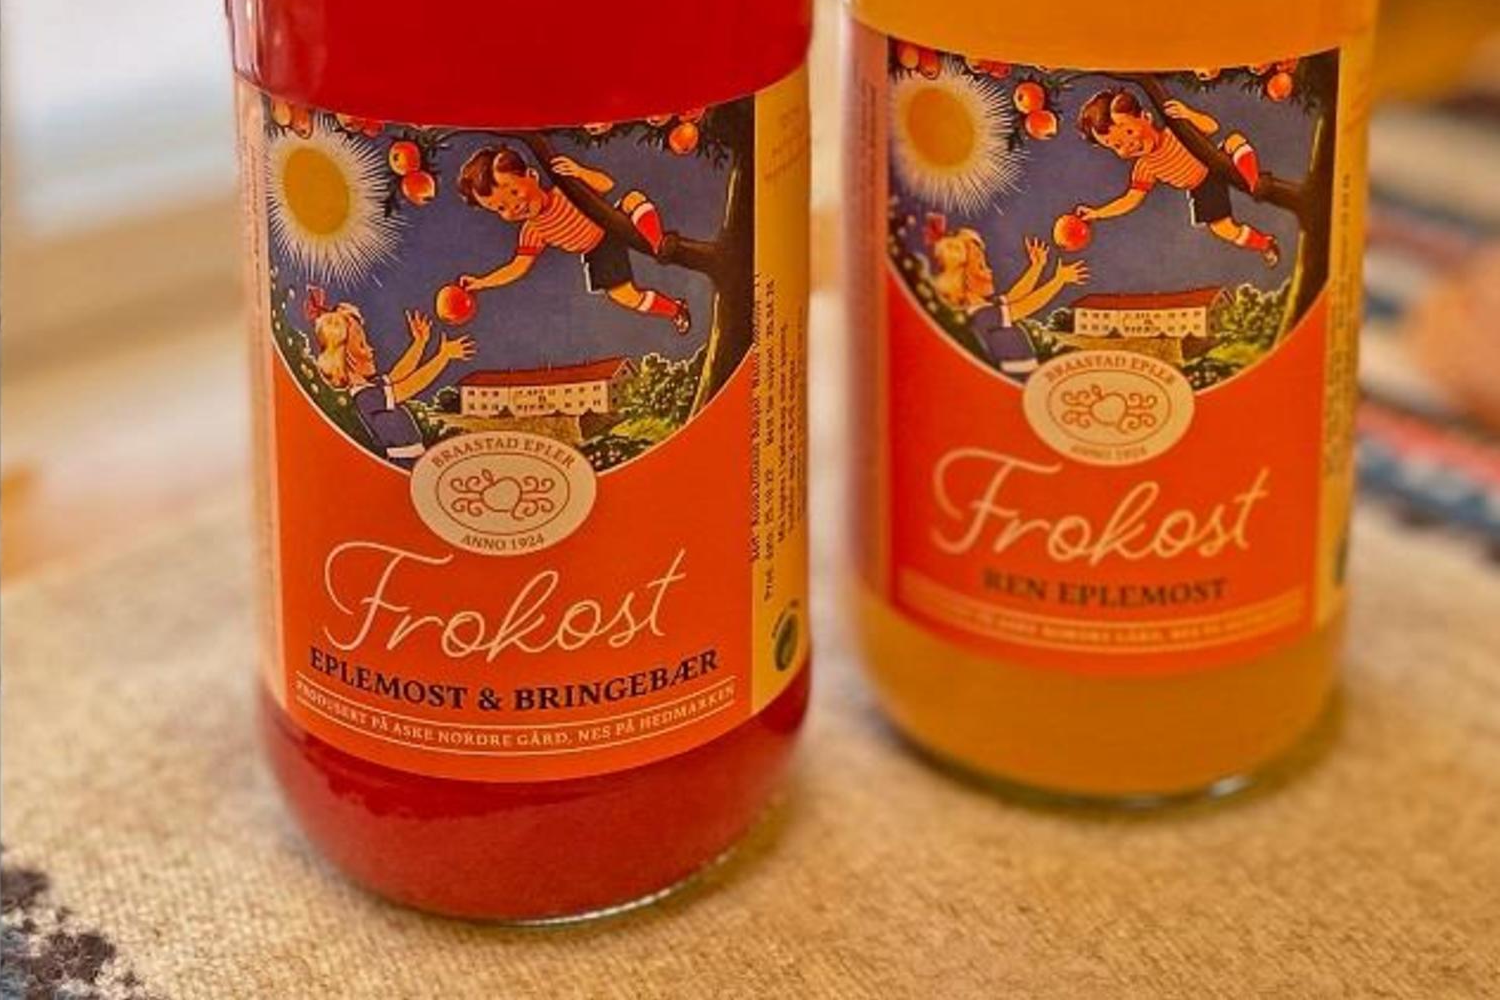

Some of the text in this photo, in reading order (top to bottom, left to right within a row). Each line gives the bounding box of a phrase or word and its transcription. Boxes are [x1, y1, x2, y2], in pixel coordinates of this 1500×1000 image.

[430, 437, 577, 470] BRAASTAD EPLER
[930, 447, 1270, 567] Frokost
[460, 533, 546, 550] ANNO 1924
[323, 541, 686, 663] Frokost
[982, 566, 1228, 608] REN EPLEMOST
[310, 646, 719, 711] EPLEMOST & BRINGEBÆR
[371, 715, 389, 732] PÅ
[393, 723, 436, 741] ASKE
[438, 729, 514, 747] NORDRE
[516, 729, 573, 748] GÅRD,
[578, 724, 612, 743] NES
[616, 716, 636, 737] PÅ
[640, 684, 735, 729] HEDMARKEN
